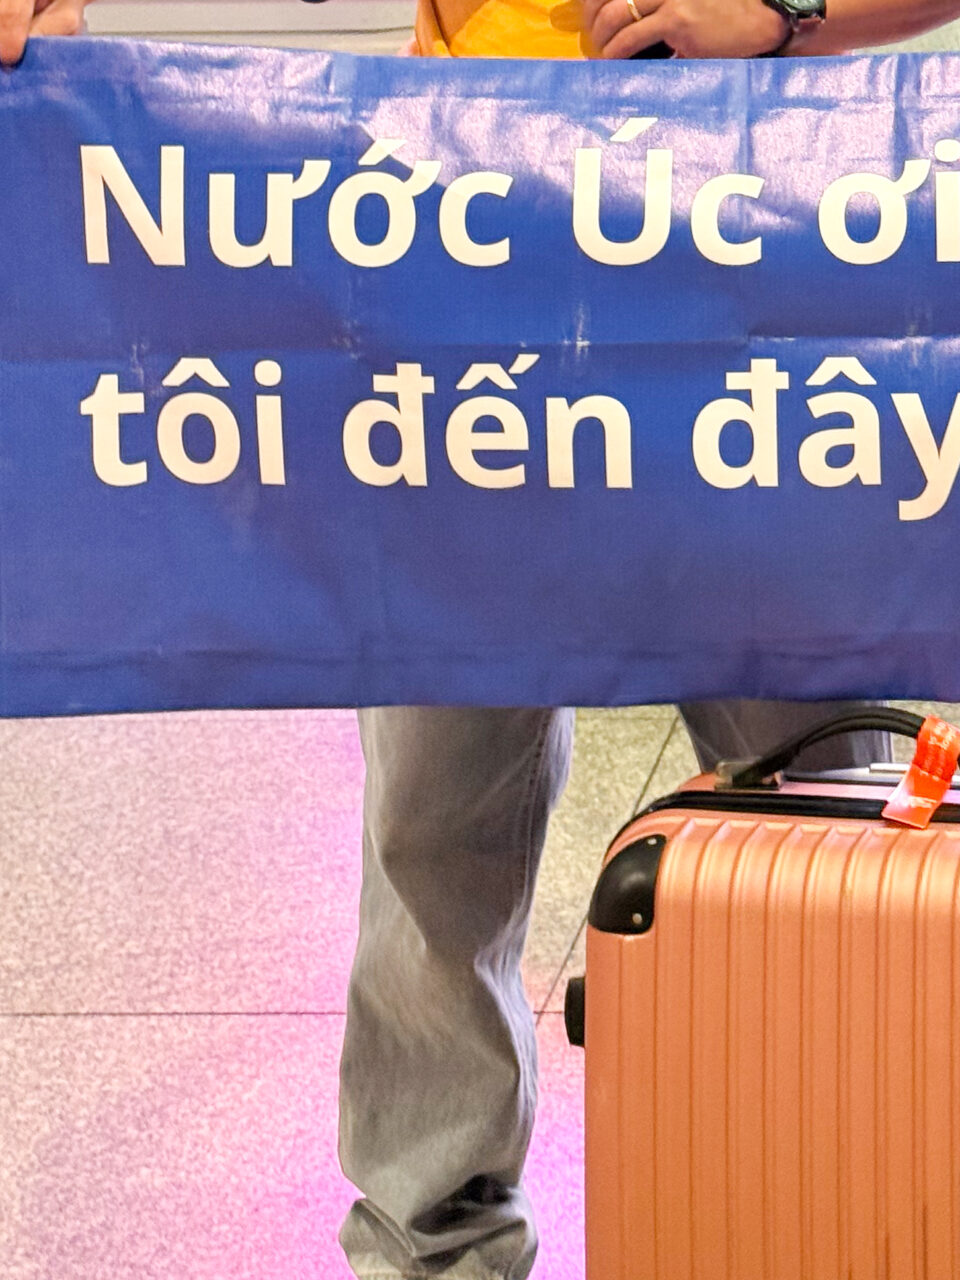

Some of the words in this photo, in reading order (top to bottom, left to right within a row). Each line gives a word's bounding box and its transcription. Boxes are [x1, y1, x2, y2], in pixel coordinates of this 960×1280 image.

[80, 136, 514, 269] Nước
[572, 116, 766, 267] Úc
[80, 356, 287, 488] tôi
[341, 352, 634, 490] đến
